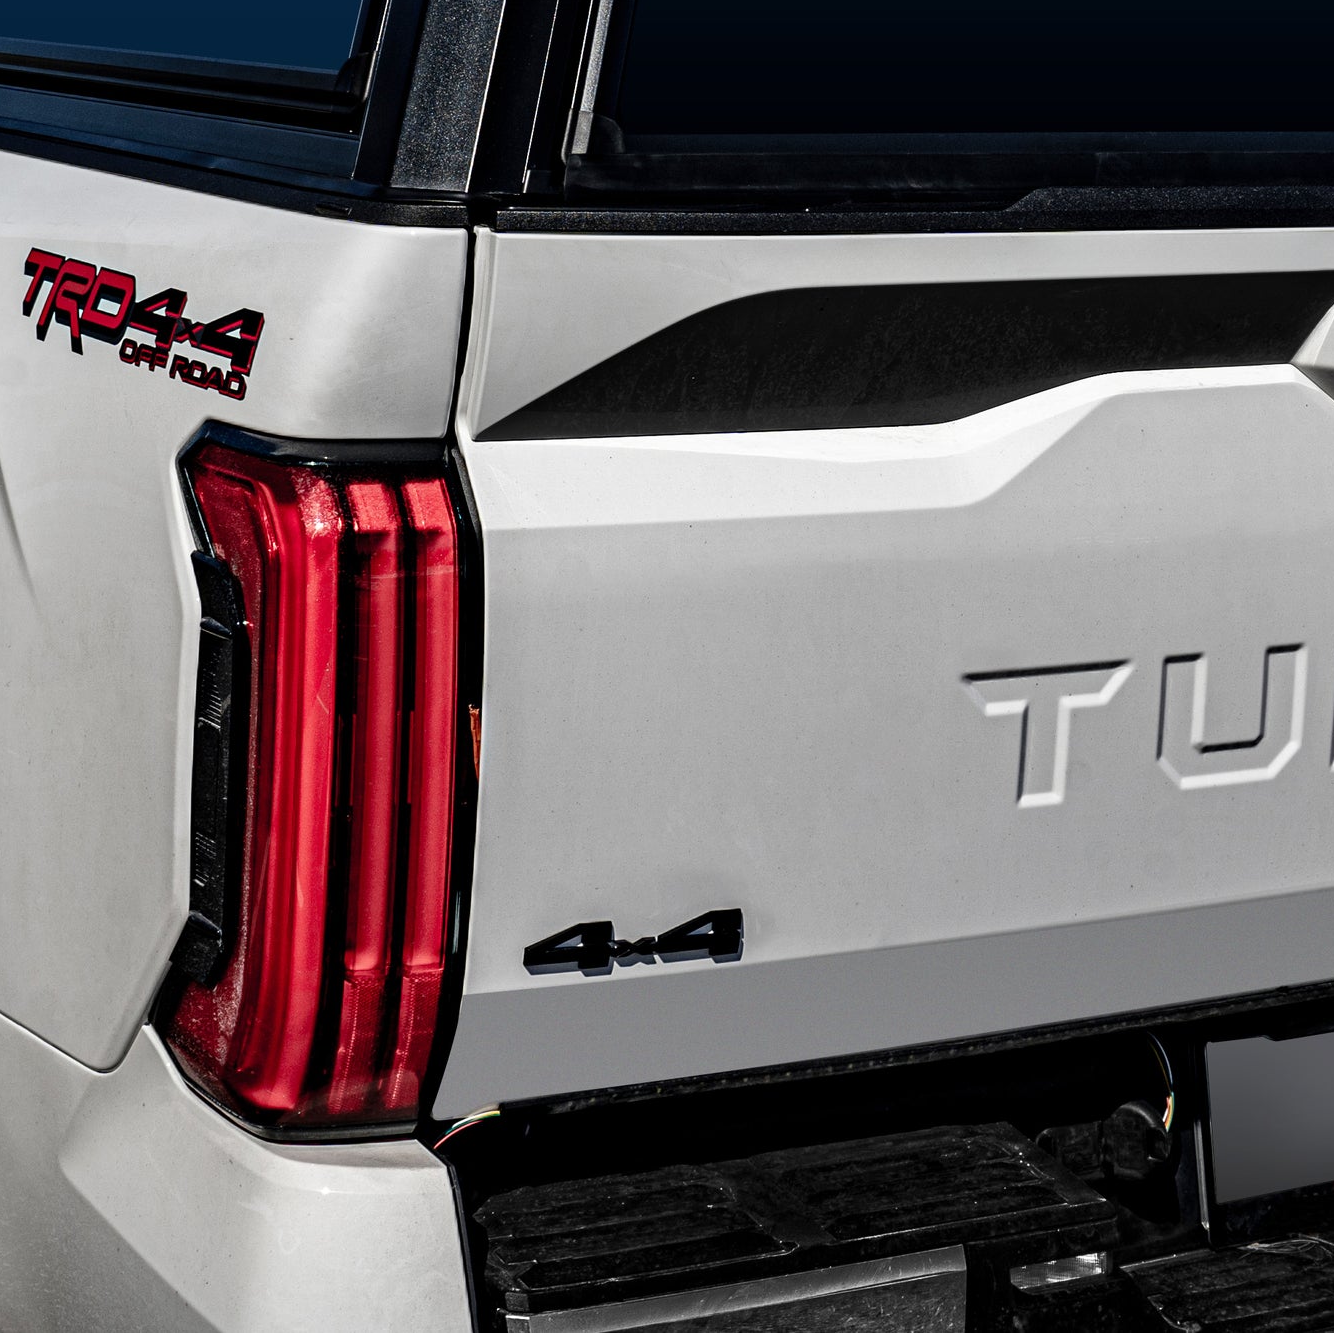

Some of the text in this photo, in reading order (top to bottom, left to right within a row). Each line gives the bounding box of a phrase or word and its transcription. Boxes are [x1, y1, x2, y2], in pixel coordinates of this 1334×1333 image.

[22, 247, 136, 355] TRD
[119, 338, 247, 401] OFF ROAD
